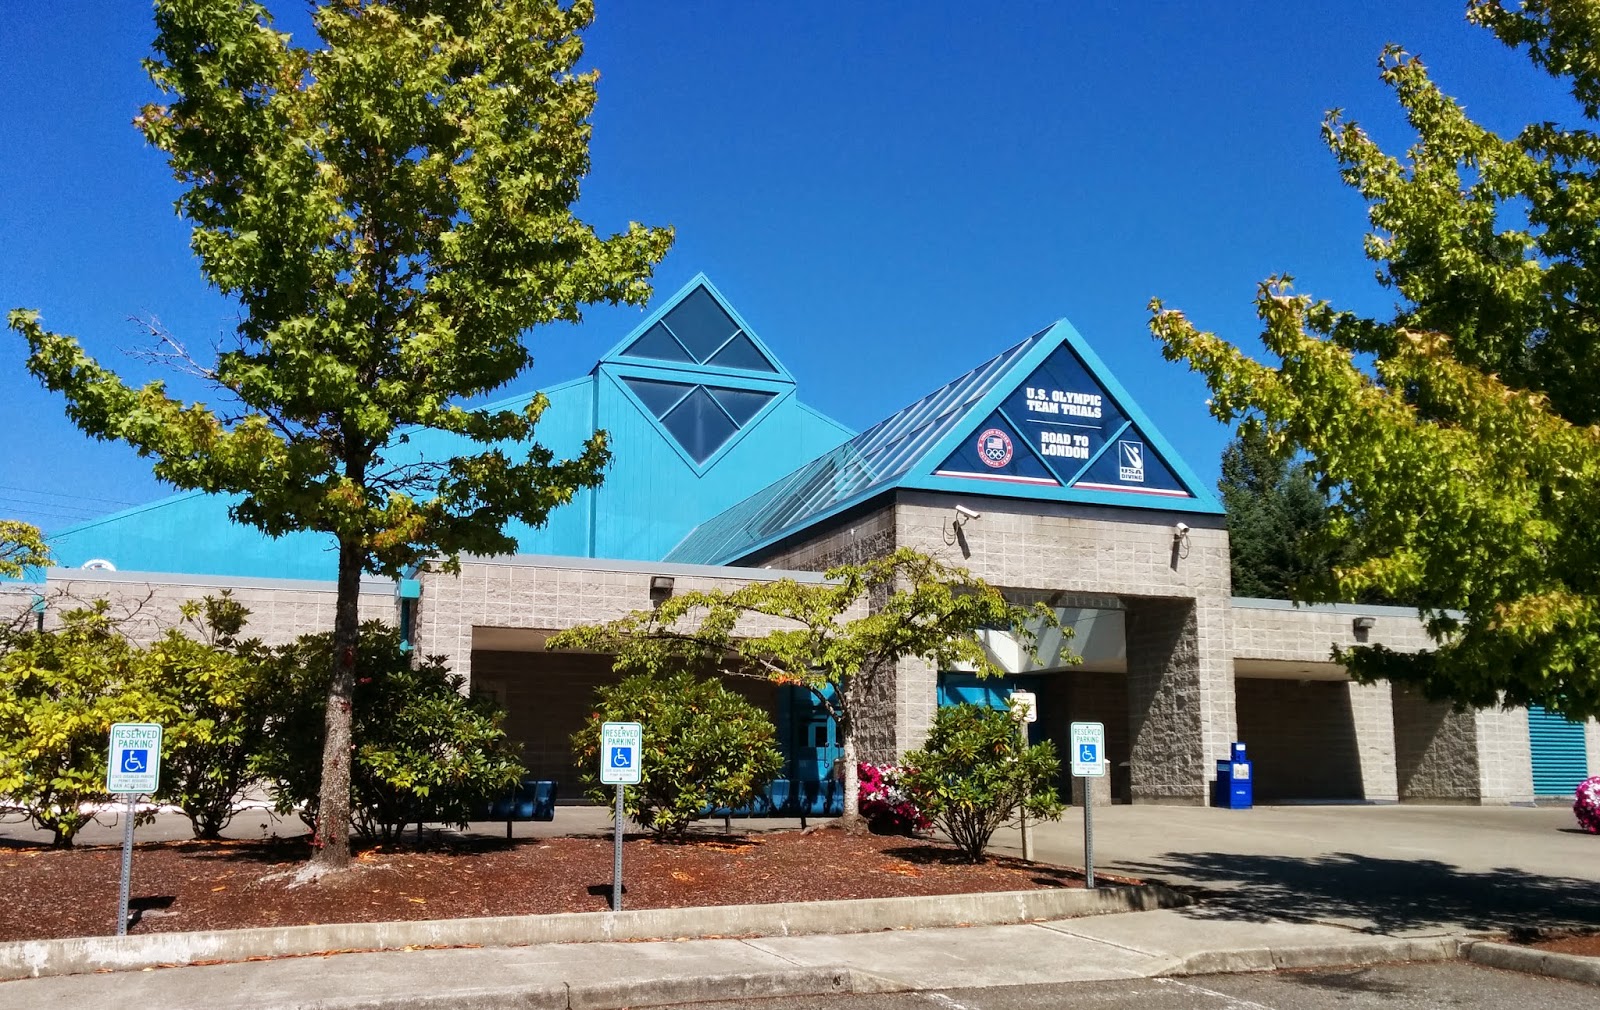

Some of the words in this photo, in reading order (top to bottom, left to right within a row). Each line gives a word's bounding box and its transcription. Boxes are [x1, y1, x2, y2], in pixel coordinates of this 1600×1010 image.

[1026, 387, 1049, 401] U.S.
[1052, 390, 1102, 406] OLYMPIC
[1026, 400, 1059, 414] TEAM
[1061, 403, 1102, 418] TRIALS
[1041, 431, 1070, 445] ROAD
[1073, 434, 1089, 447] TO
[1041, 443, 1089, 459] LONDON
[115, 730, 158, 739] RESERVED
[605, 729, 638, 738] RESERVED
[118, 739, 154, 748] PARKING
[607, 738, 636, 746] PARKING
